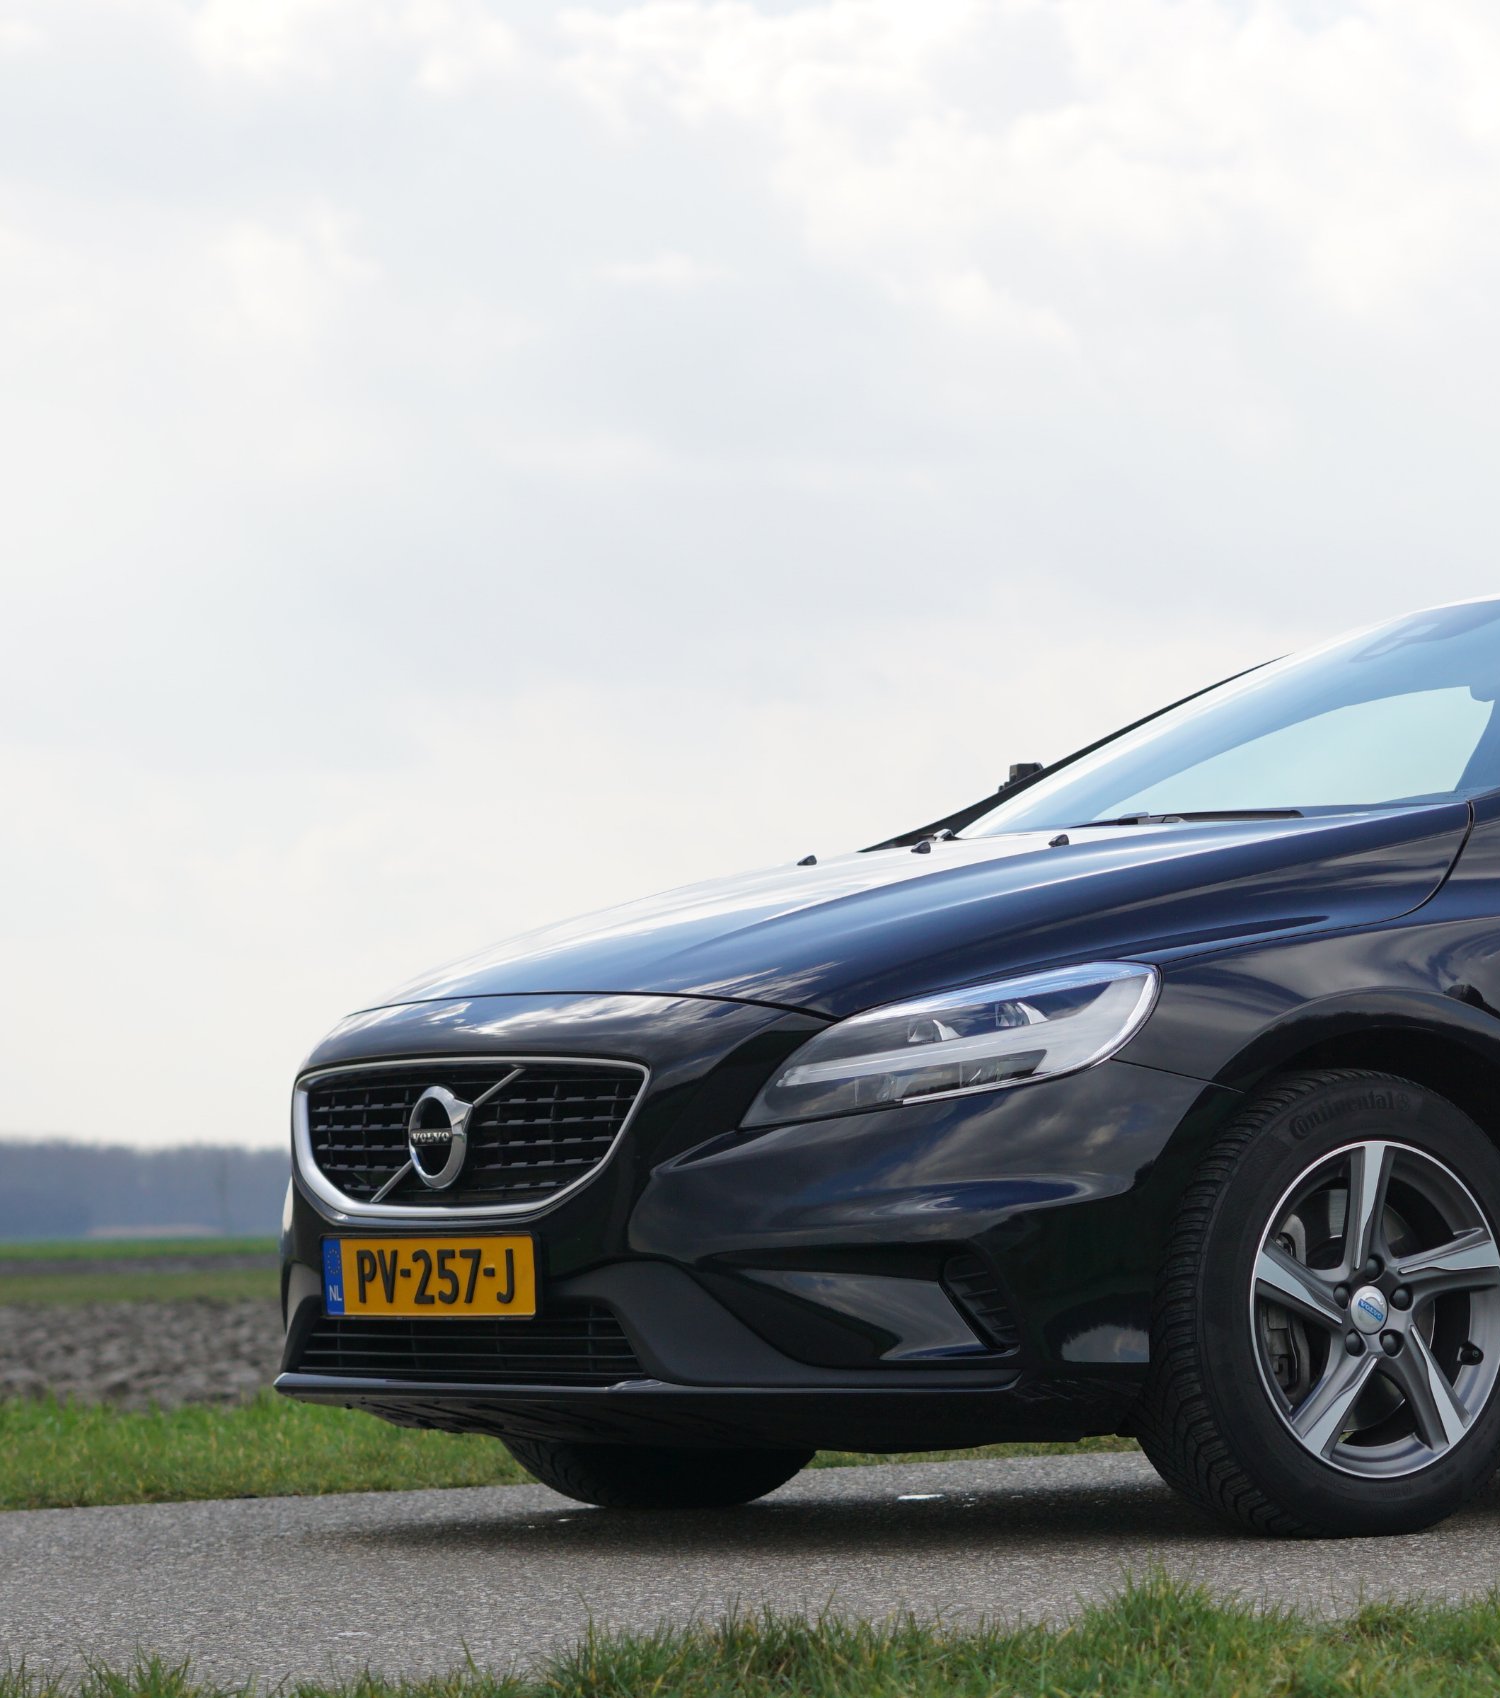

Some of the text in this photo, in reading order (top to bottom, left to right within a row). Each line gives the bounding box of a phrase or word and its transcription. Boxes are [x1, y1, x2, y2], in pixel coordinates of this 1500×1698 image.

[412, 1131, 450, 1142] VOLVO
[356, 1248, 515, 1304] PV-257-J
[329, 1285, 342, 1301] NL
[1358, 1299, 1383, 1320] VOLVO
